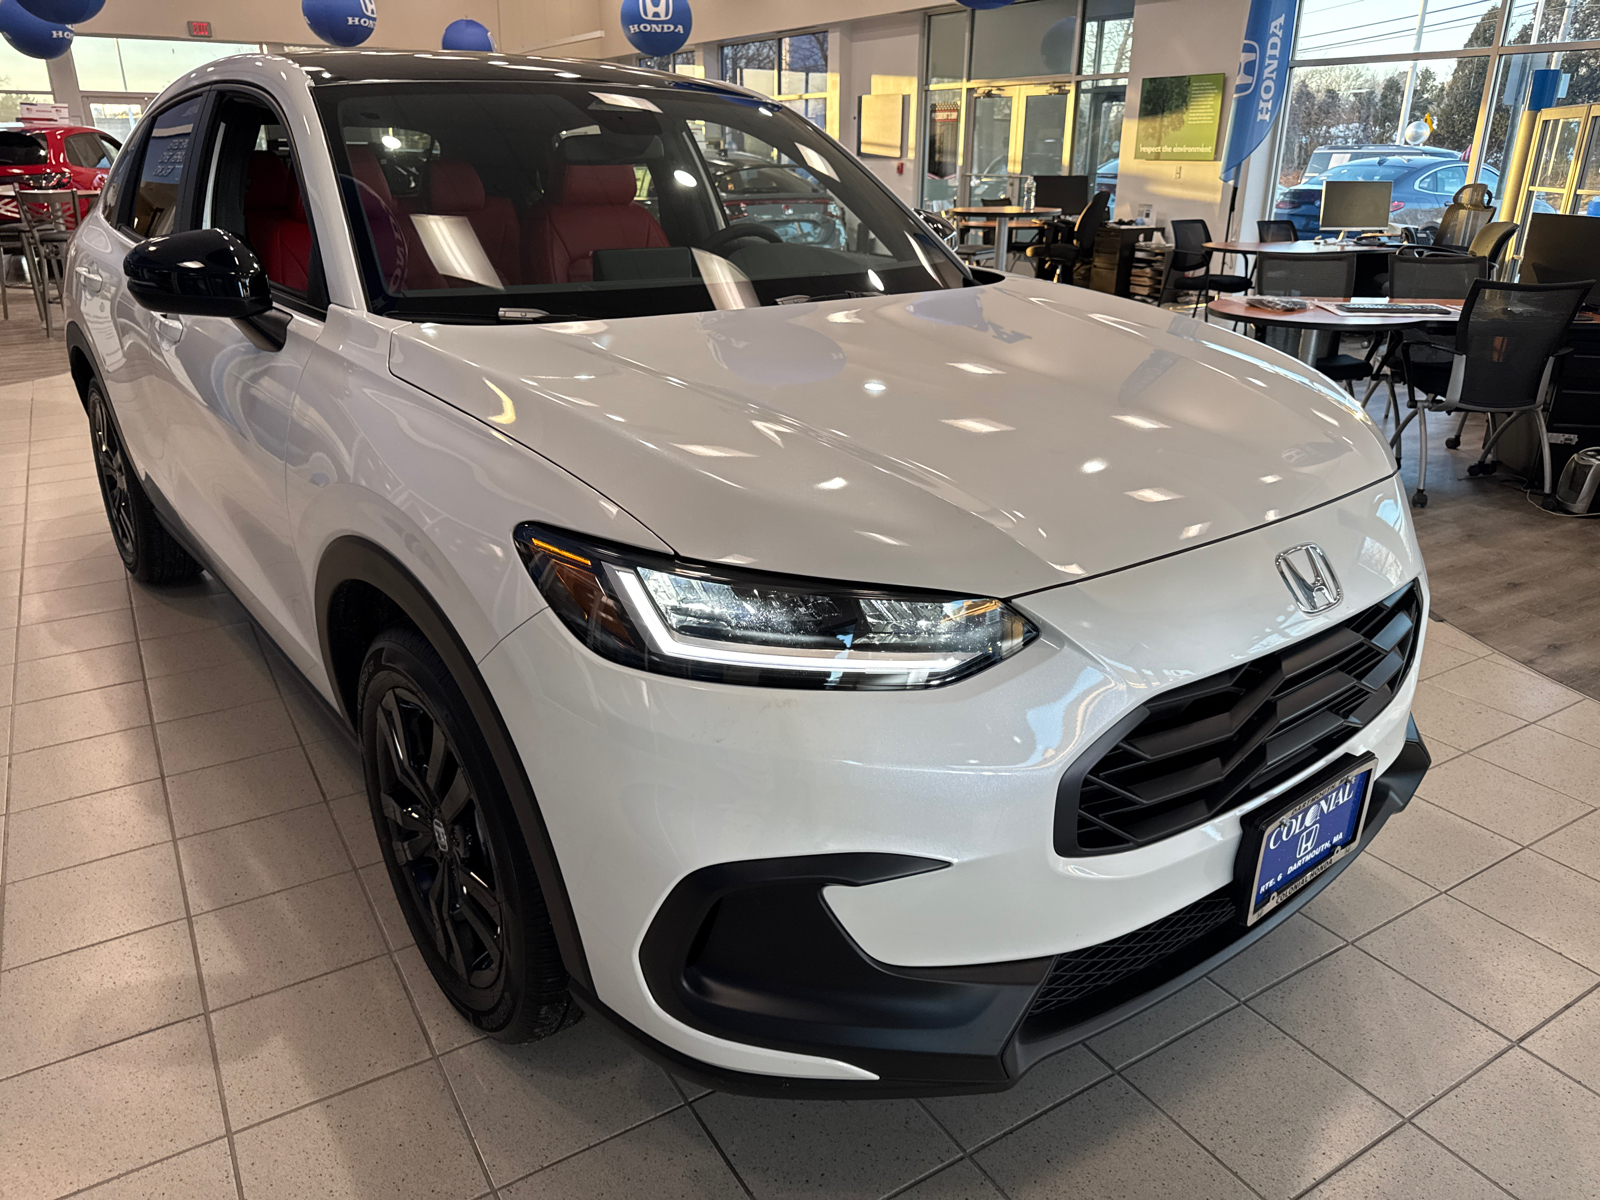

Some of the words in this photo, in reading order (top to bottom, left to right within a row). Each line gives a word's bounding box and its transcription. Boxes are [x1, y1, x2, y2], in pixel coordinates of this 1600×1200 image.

[628, 23, 685, 34] HONDA
[1257, 13, 1285, 122] HONDA
[1140, 143, 1162, 154] respect
[1162, 145, 1173, 153] the
[1173, 142, 1213, 153] environment
[1269, 782, 1354, 850] COLONIAL
[1259, 878, 1276, 894] RTE.
[1276, 873, 1284, 882] 6
[1286, 840, 1332, 875] DARTMOUTH,
[1332, 831, 1343, 845] MA
[1275, 877, 1309, 904] COLONIAL
[1308, 857, 1334, 880] HONDA
